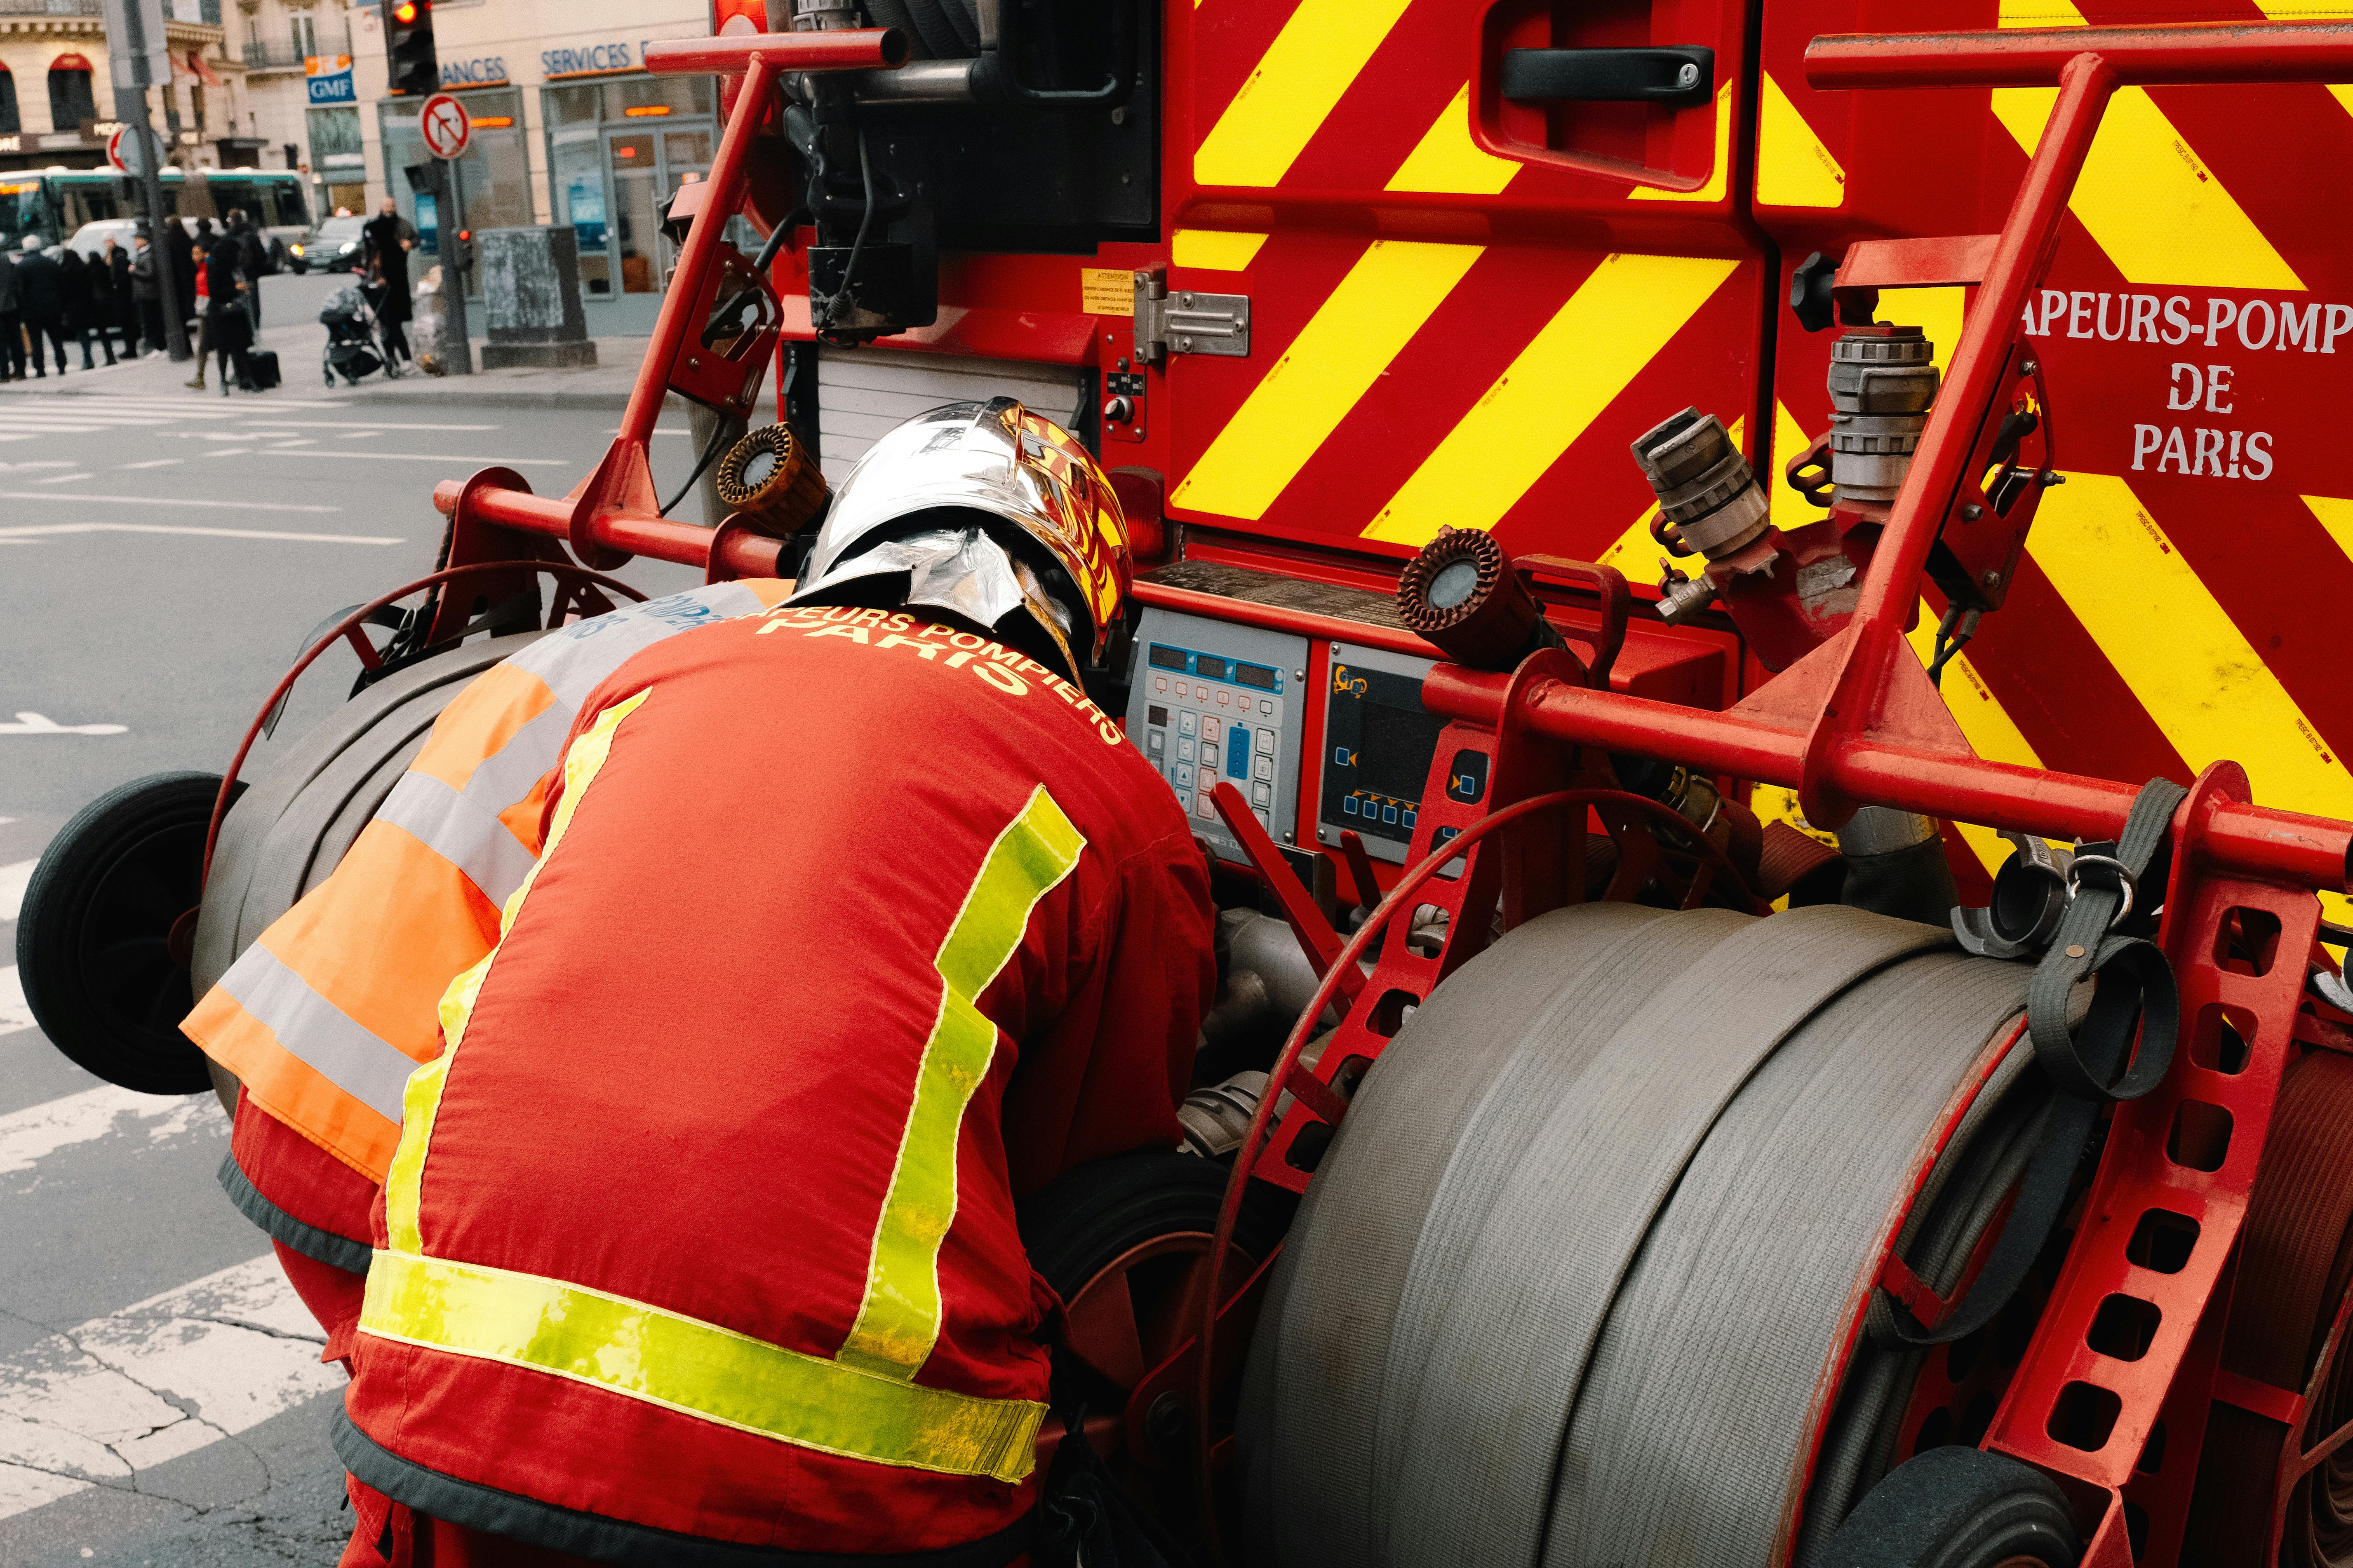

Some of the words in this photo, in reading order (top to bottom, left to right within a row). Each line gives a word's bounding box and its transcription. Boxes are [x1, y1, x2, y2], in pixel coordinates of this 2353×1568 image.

[541, 43, 630, 75] SERVICES
[310, 79, 350, 98] GMF
[1834, 174, 1844, 184] 3M
[2171, 140, 2186, 156] TPESC
[2196, 171, 2208, 183] 3M
[2167, 363, 2234, 414] DE
[2131, 424, 2273, 481] PARIS
[2134, 511, 2149, 527] TPESC
[2159, 542, 2171, 554] 3M
[719, 606, 916, 632] APEURS
[918, 622, 1126, 745] POMPIERS
[755, 618, 1033, 696] PARIS
[1957, 660, 1971, 675] TPESC
[1979, 690, 1989, 701] 3M
[2294, 718, 2309, 735] TPESC
[2308, 737, 2322, 751] 07192
[2320, 751, 2332, 764] 3M
